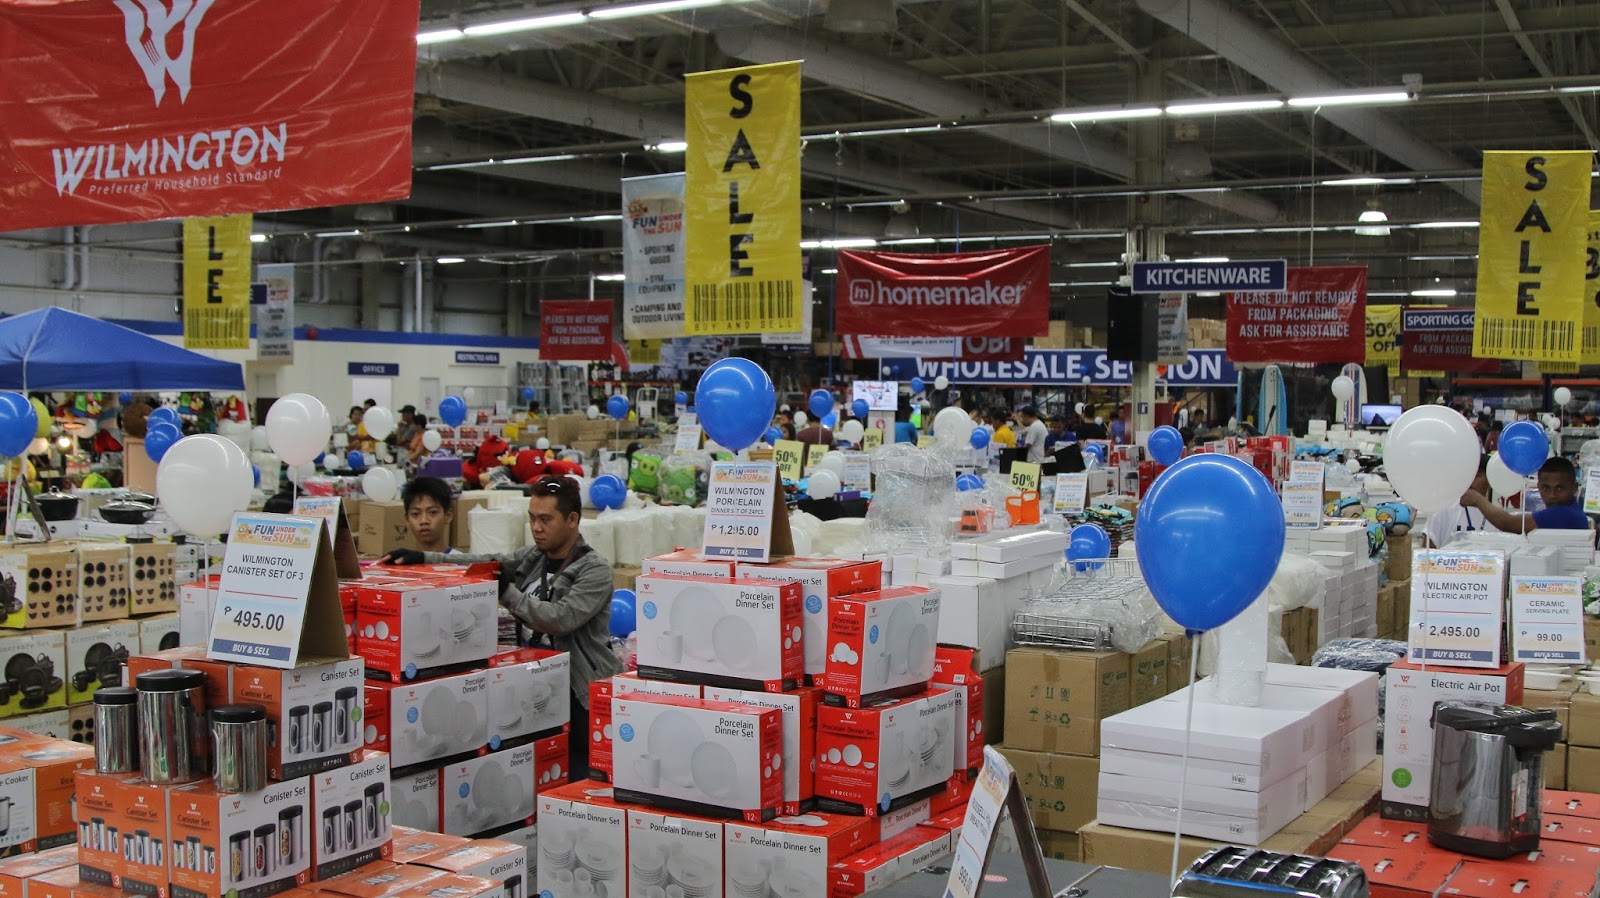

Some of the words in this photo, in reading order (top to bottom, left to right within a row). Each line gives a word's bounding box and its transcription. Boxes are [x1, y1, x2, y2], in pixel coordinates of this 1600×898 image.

[52, 122, 287, 198] WILMINGTON
[88, 180, 148, 195] Preferred
[154, 173, 219, 189] Household
[225, 166, 281, 184] Standard
[722, 74, 760, 277] SALE
[632, 215, 658, 229] FUN
[658, 213, 682, 222] UNDER
[657, 221, 682, 234] SUN
[1514, 156, 1551, 316] SALE
[649, 255, 671, 264] GOODS
[1145, 267, 1271, 286] KITCHENWARE
[638, 284, 676, 294] EQUIPMENT
[878, 279, 1024, 306] homemaker
[1234, 292, 1272, 304] PLEASE
[1275, 292, 1289, 304] DO
[1292, 291, 1313, 304] NOT
[1315, 291, 1358, 304] REMOVE
[634, 303, 665, 313] CAMPING
[667, 302, 681, 311] AND
[632, 314, 662, 323] OUTDOOR
[1248, 308, 1276, 321] FROM
[1280, 307, 1342, 321] PACKAGING,
[1407, 314, 1460, 326] SPORTING
[727, 321, 750, 330] AND
[760, 320, 793, 329] SELL
[1239, 324, 1260, 337] ASK
[1263, 324, 1284, 337] FOR
[1286, 323, 1350, 337] ASSISTANCE
[1420, 334, 1440, 343] FROM
[1413, 345, 1428, 353] ASK
[1430, 345, 1443, 353] FOR
[362, 365, 385, 374] OFFICE
[915, 355, 1076, 380] WHOLESALE
[775, 450, 798, 464] 50%
[779, 464, 791, 473] OFF
[1012, 473, 1035, 487] 50%
[714, 487, 765, 496] WILMNGTON
[253, 524, 276, 535] FUN
[272, 532, 295, 544] SUN
[242, 554, 294, 567] WILMINGTON
[1436, 558, 1458, 567] FUN
[226, 565, 267, 577] CANISTER
[268, 570, 284, 579] SET
[286, 570, 297, 580] OF
[298, 571, 304, 581] 3
[1456, 563, 1479, 572] SUN
[811, 578, 822, 586] Set
[1425, 582, 1488, 592] WILMINGTON
[451, 593, 472, 601] Porcelain
[473, 590, 488, 599] Dinner
[740, 591, 774, 602] Porcelain
[736, 598, 760, 609] Dinner
[762, 600, 774, 610] Set
[1529, 600, 1565, 608] CERAMIC
[233, 610, 285, 632] 495.00
[1429, 625, 1480, 638] 2,495.00
[1537, 633, 1562, 642] 99.00
[232, 643, 246, 653] BUY
[247, 645, 254, 654] &
[254, 646, 270, 656] SELL
[320, 671, 347, 682] Canister
[348, 667, 360, 678] Set
[392, 673, 399, 681] 16
[465, 676, 486, 686] Porcelain
[815, 677, 824, 686] 24
[1431, 679, 1465, 690] Electric
[1468, 681, 1481, 691] Air
[1484, 682, 1500, 693] Pot
[462, 684, 478, 694] Dinner
[768, 683, 776, 692] 12
[783, 703, 794, 712] Set
[847, 699, 857, 708] 12
[719, 718, 754, 730] Porcelain
[715, 726, 739, 737] Dinner
[741, 728, 754, 738] Set
[271, 768, 277, 778] 3
[349, 767, 375, 781] Canister
[375, 763, 387, 774] Set
[5, 775, 29, 786] Cooker
[415, 773, 437, 785] Porcelain
[412, 782, 428, 793] Dinner
[429, 779, 437, 788] Set
[263, 789, 293, 804] Canister
[294, 786, 306, 797] Set
[785, 805, 794, 813] 24
[865, 807, 873, 816] 16
[558, 808, 586, 820] Porcelain
[587, 812, 607, 823] Dinner
[609, 817, 620, 825] Set
[747, 812, 755, 821] 12
[650, 822, 680, 835] Porcelain
[681, 827, 703, 839] Dinner
[705, 831, 716, 840] Set
[750, 836, 782, 849] Porcelain
[784, 841, 807, 852] Dinner
[809, 844, 821, 854] Set
[490, 859, 514, 876] Canister
[514, 856, 524, 867] Set
[114, 875, 120, 886] 3
[300, 873, 305, 883] 3
